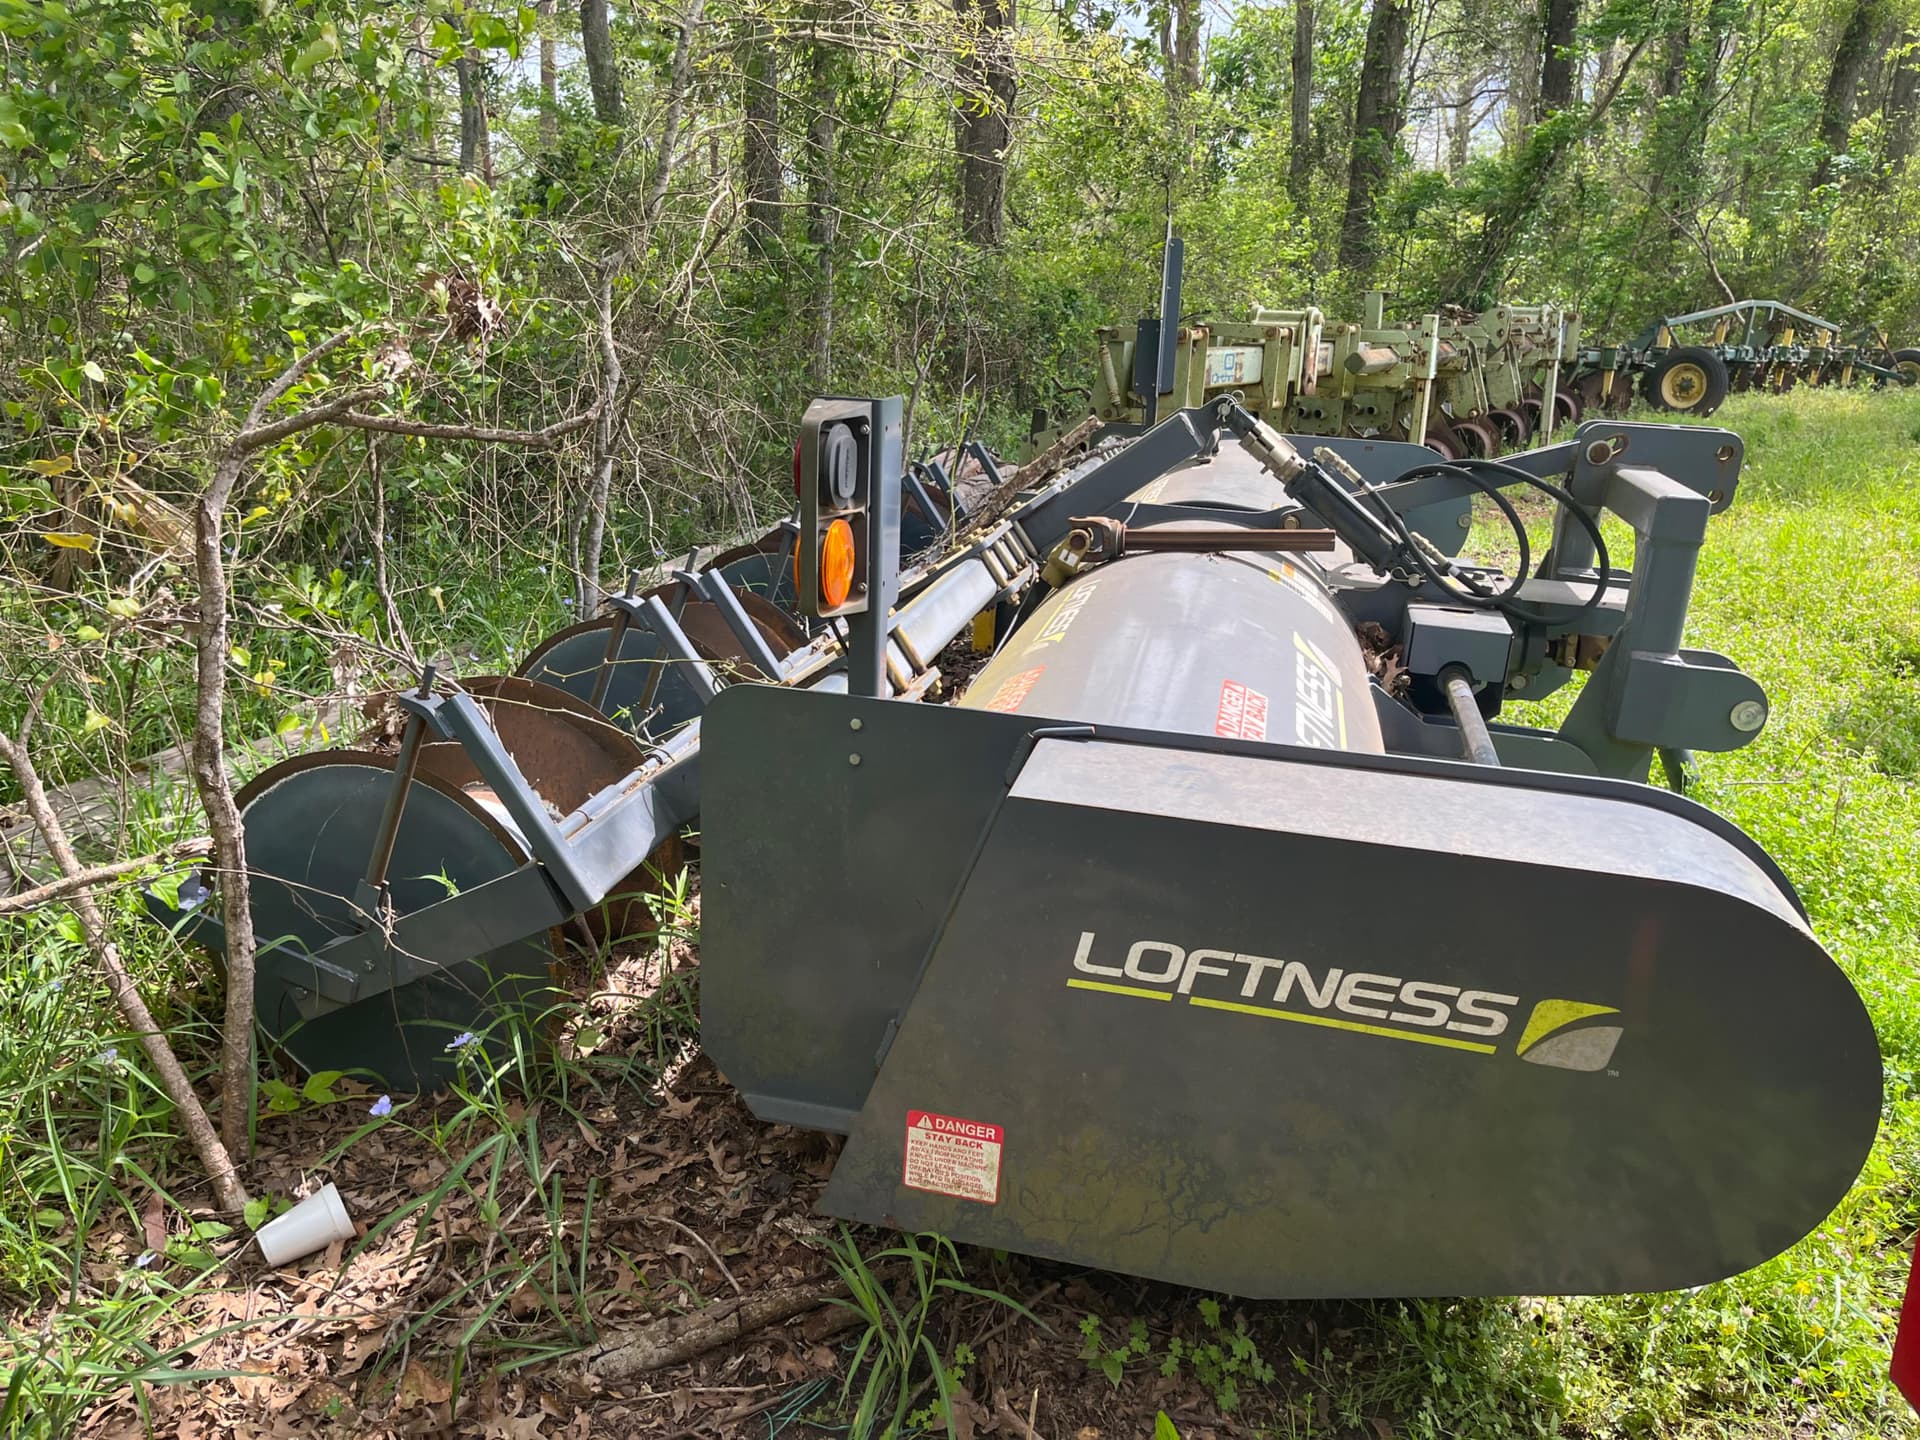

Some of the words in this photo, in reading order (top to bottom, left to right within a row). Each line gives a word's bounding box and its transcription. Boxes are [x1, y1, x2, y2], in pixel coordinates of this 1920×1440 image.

[1296, 649, 1335, 748] FTNESS
[1073, 931, 1520, 1036] LOFTNESS
[924, 1132, 952, 1143] STAY
[955, 1138, 983, 1150] BACK
[936, 1118, 995, 1139] DANGER
